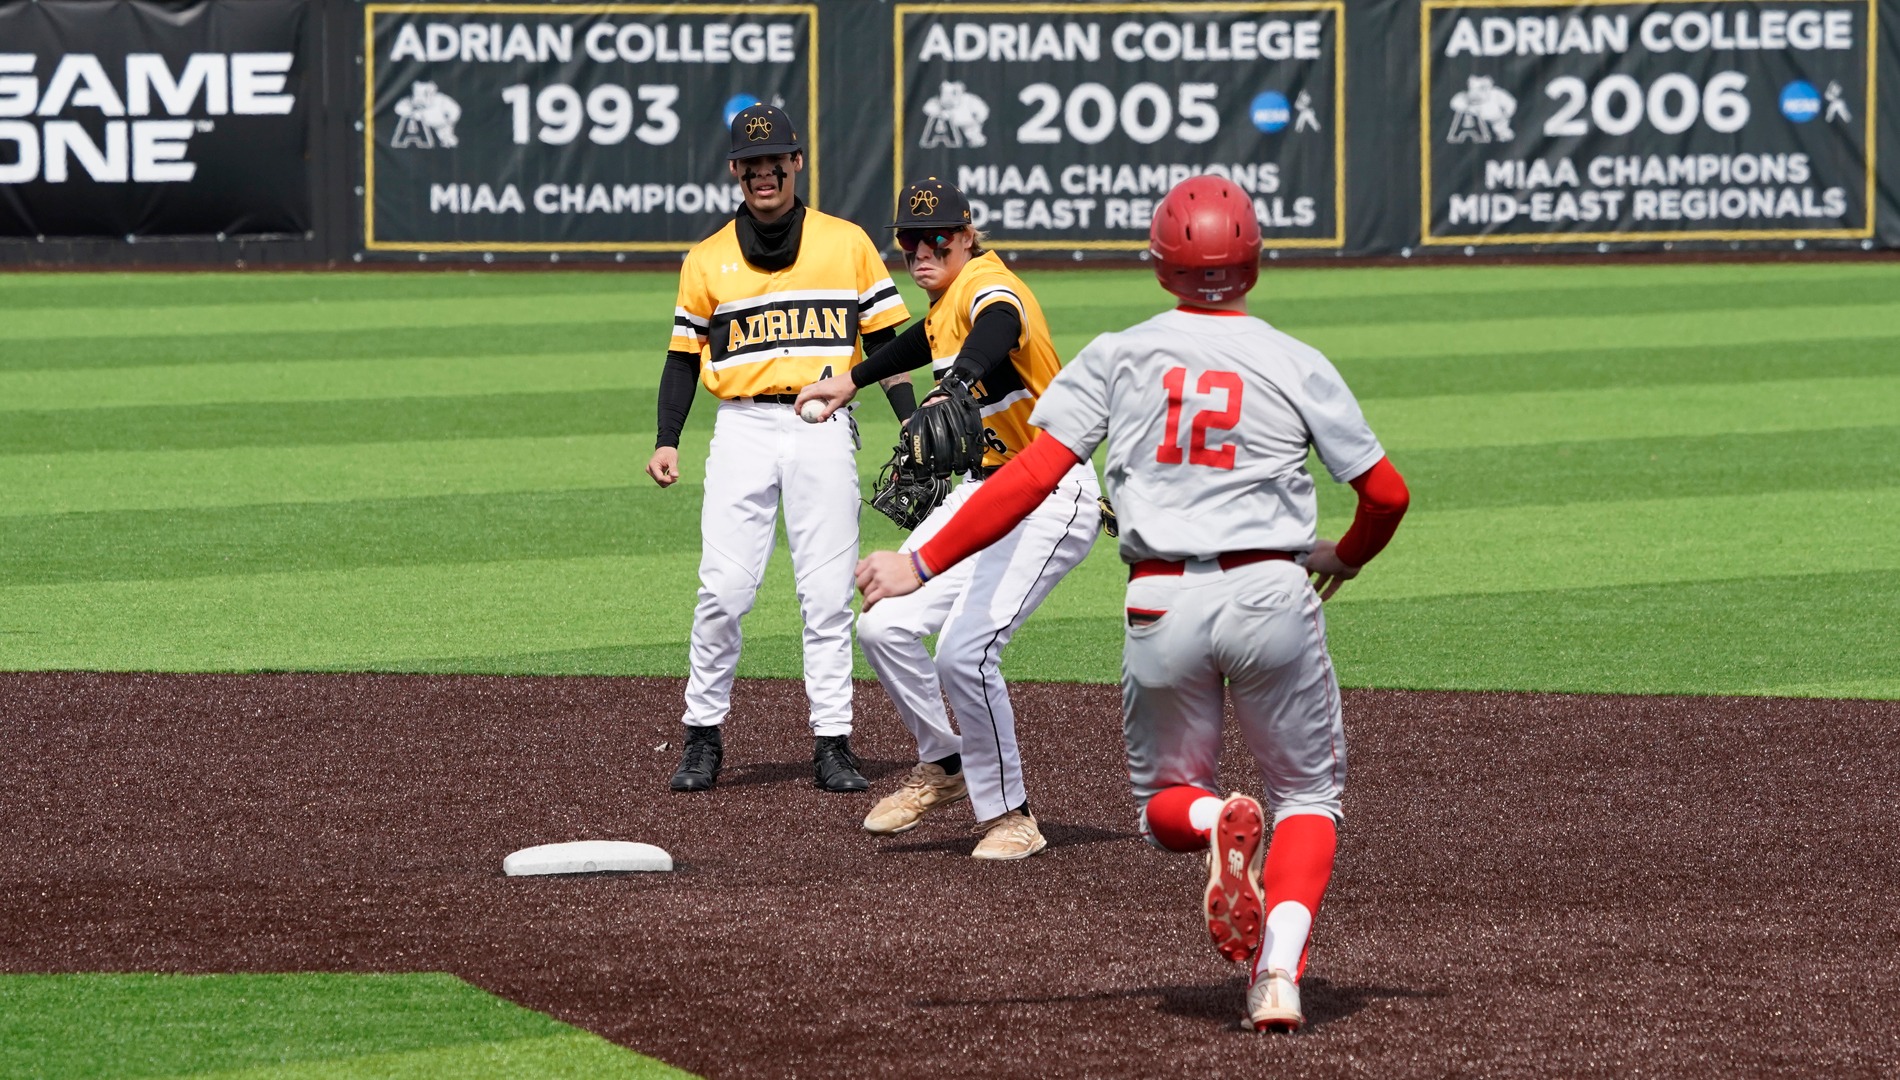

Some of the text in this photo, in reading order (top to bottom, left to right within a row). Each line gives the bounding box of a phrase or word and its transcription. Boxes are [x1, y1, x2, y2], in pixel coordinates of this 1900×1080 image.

[391, 23, 795, 63] ADRIAN COLLEGE
[919, 21, 1321, 62] ADRIAN COLLEGE
[1445, 11, 1853, 57] ADRIAN COLLEGE
[502, 84, 681, 145] 1993
[1016, 82, 1220, 144] 2005
[1544, 71, 1751, 136] 2006
[958, 164, 1053, 195] MIAA
[1485, 153, 1811, 189] MIAA CHAMPIONS
[430, 184, 525, 213] MIAA
[969, 196, 1316, 230] D-EAST REALS
[1449, 187, 1847, 225] MID-EAST REGIONALS
[727, 307, 848, 352] ADRIAN
[1156, 366, 1244, 471] 12
[913, 435, 924, 465] A2000
